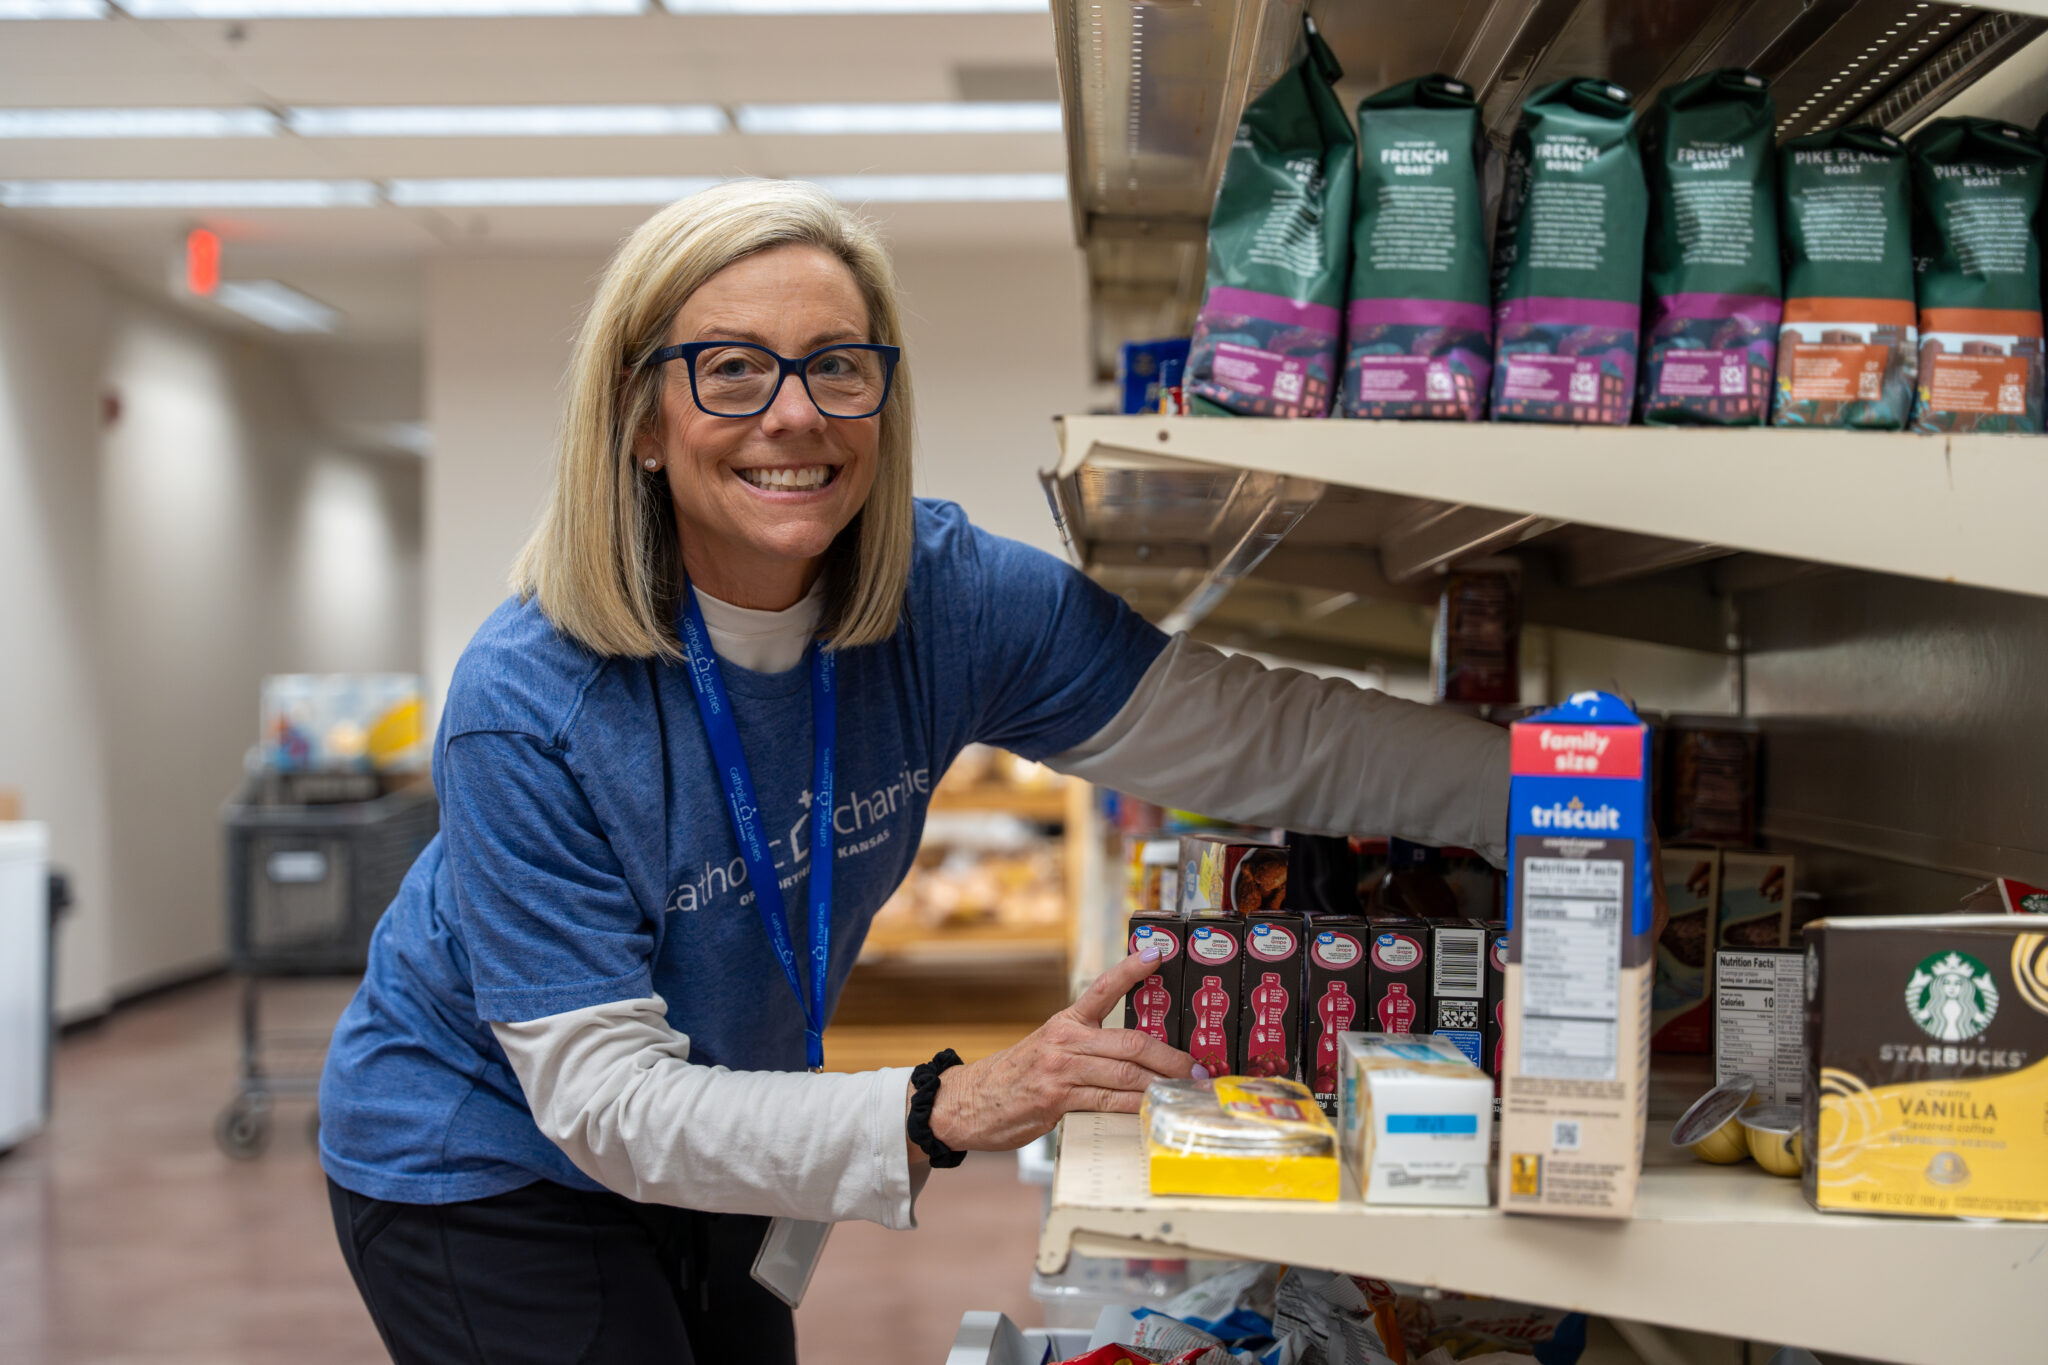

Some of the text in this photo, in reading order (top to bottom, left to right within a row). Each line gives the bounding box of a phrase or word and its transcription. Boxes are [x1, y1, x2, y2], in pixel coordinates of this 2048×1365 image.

[1380, 149, 1449, 165] FRENCH
[1535, 143, 1600, 162] FRENCH
[1677, 145, 1745, 162] FRENCH
[1795, 151, 1833, 165] PIKE
[1394, 165, 1433, 177] ROAST
[1545, 160, 1584, 173] ROAST
[1692, 159, 1730, 171] ROAST
[1823, 165, 1861, 176] ROAST
[1933, 164, 1972, 180] PIKE
[1963, 176, 2001, 188] ROAST
[683, 617, 721, 715] catholic charities
[1539, 729, 1610, 756] family
[1555, 752, 1599, 772] size
[729, 766, 763, 863] catholic charities
[1531, 802, 1620, 831] triscuit
[819, 806, 828, 848] catholic
[665, 760, 929, 912] catho chariie
[837, 828, 891, 859] KANSAS
[816, 902, 825, 944] charities
[1720, 956, 1774, 969] Nutrition Facts
[1720, 997, 1774, 1008] Calories 10
[1879, 1044, 2023, 1068] STARBUCKS
[1314, 1092, 1324, 1100] NET
[1325, 1092, 1332, 1100] WT
[1898, 1098, 1998, 1121] VANILLA
[1902, 1119, 1996, 1135] flavored coffee
